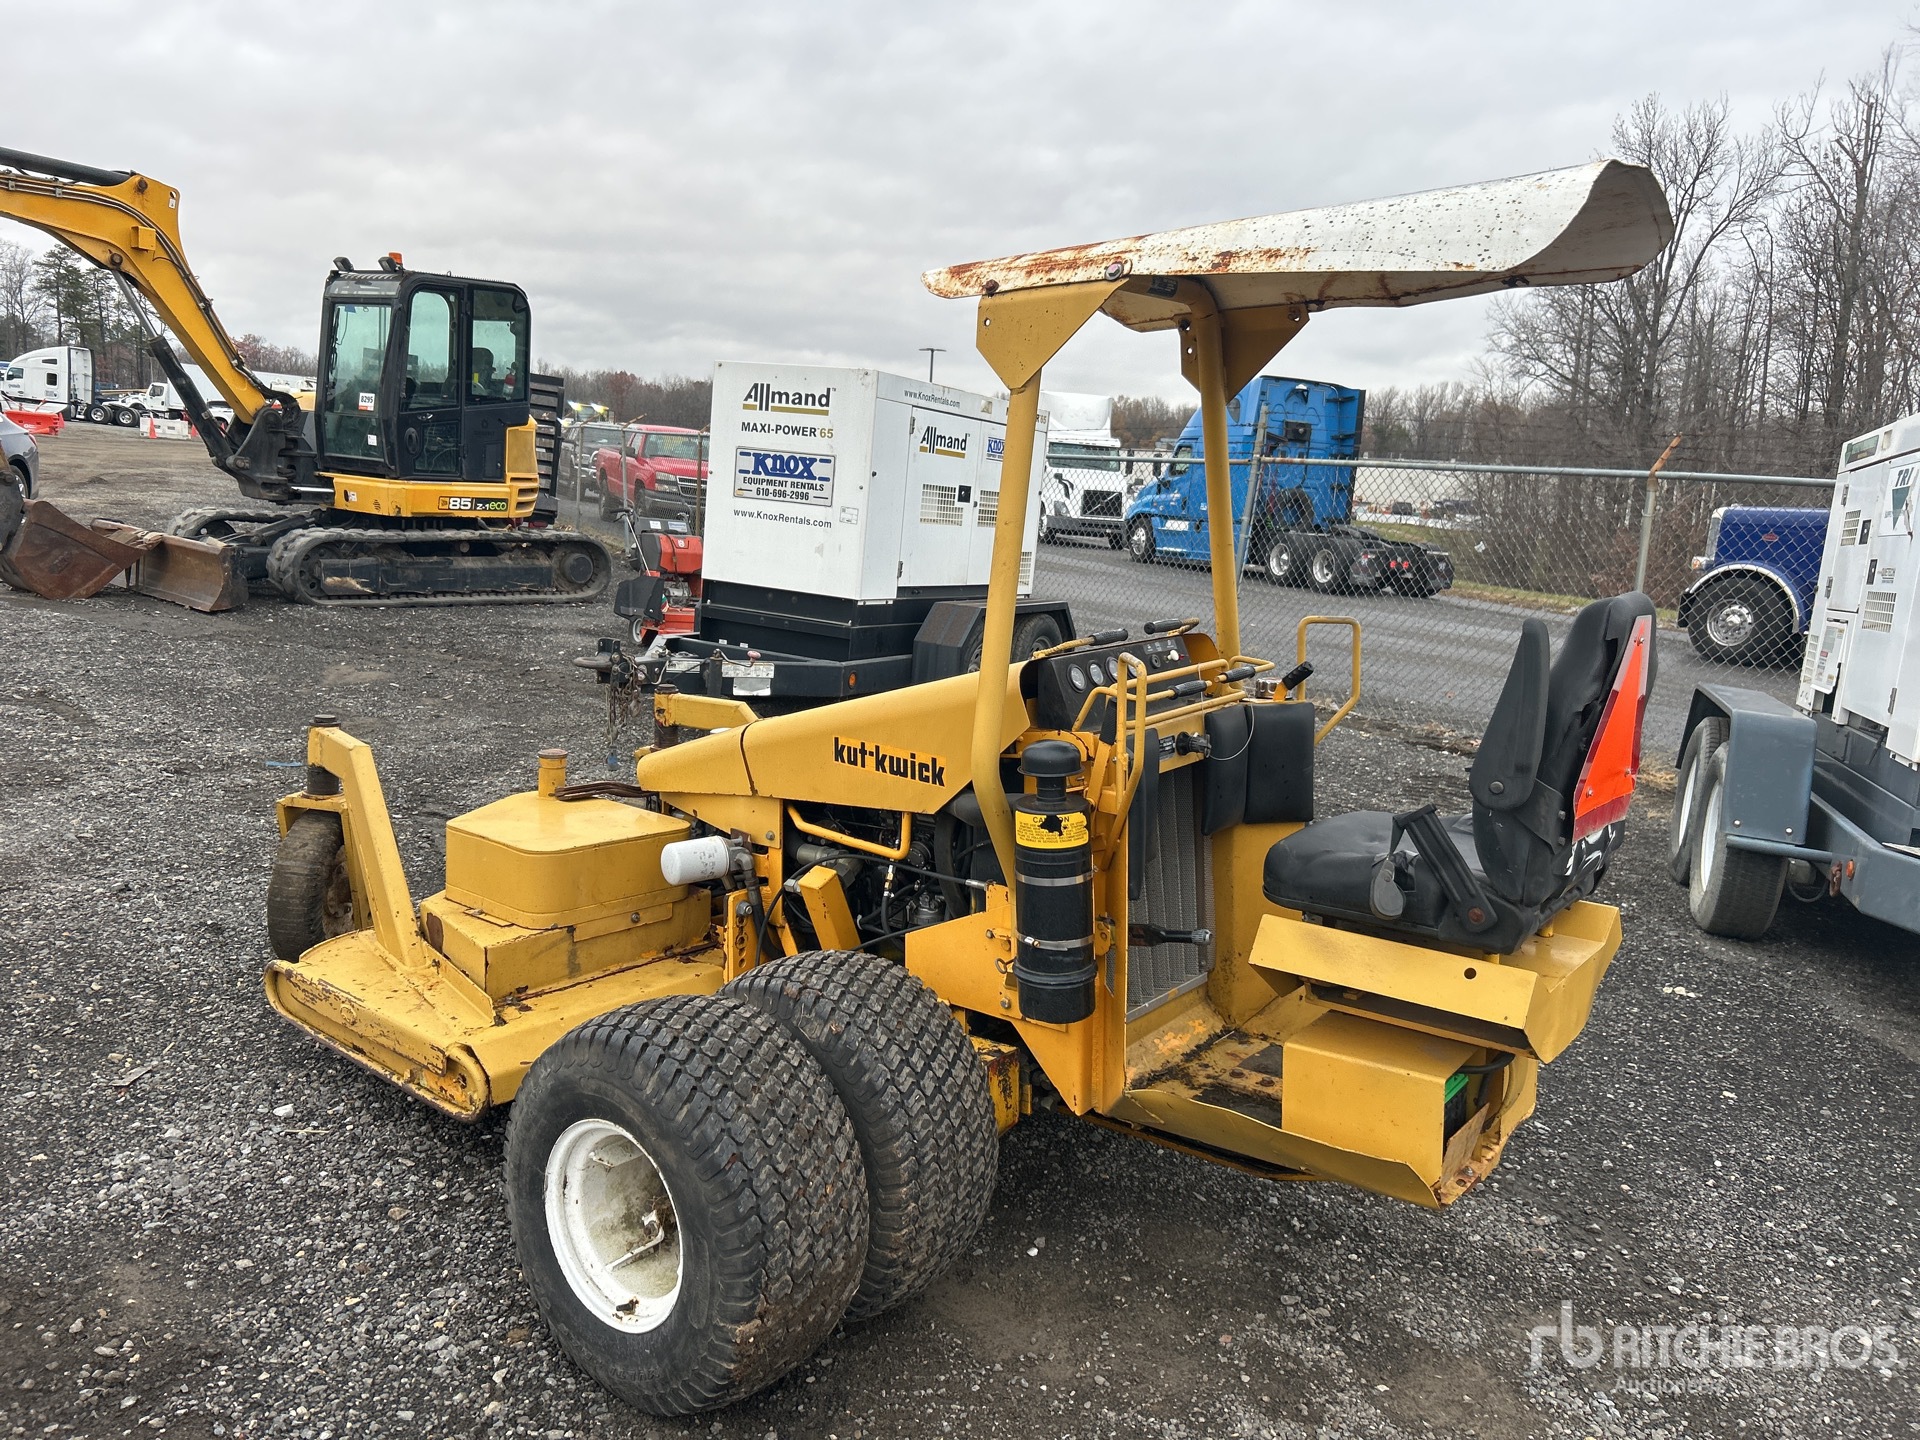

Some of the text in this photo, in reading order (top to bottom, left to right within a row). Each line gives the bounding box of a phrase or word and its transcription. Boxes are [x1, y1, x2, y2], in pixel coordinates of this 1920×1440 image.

[743, 383, 831, 411] Allmand
[904, 389, 961, 408] www.KnoxRentals.com
[741, 421, 834, 439] MAXI-POWER 65
[920, 426, 968, 454] Allmand
[743, 476, 825, 492] EQUIPMENT RENTALS
[449, 497, 472, 509] 85
[756, 487, 810, 501] 610-696-2996
[733, 509, 832, 528] www.KnoxRentals.com
[833, 736, 945, 787] kut-kwick
